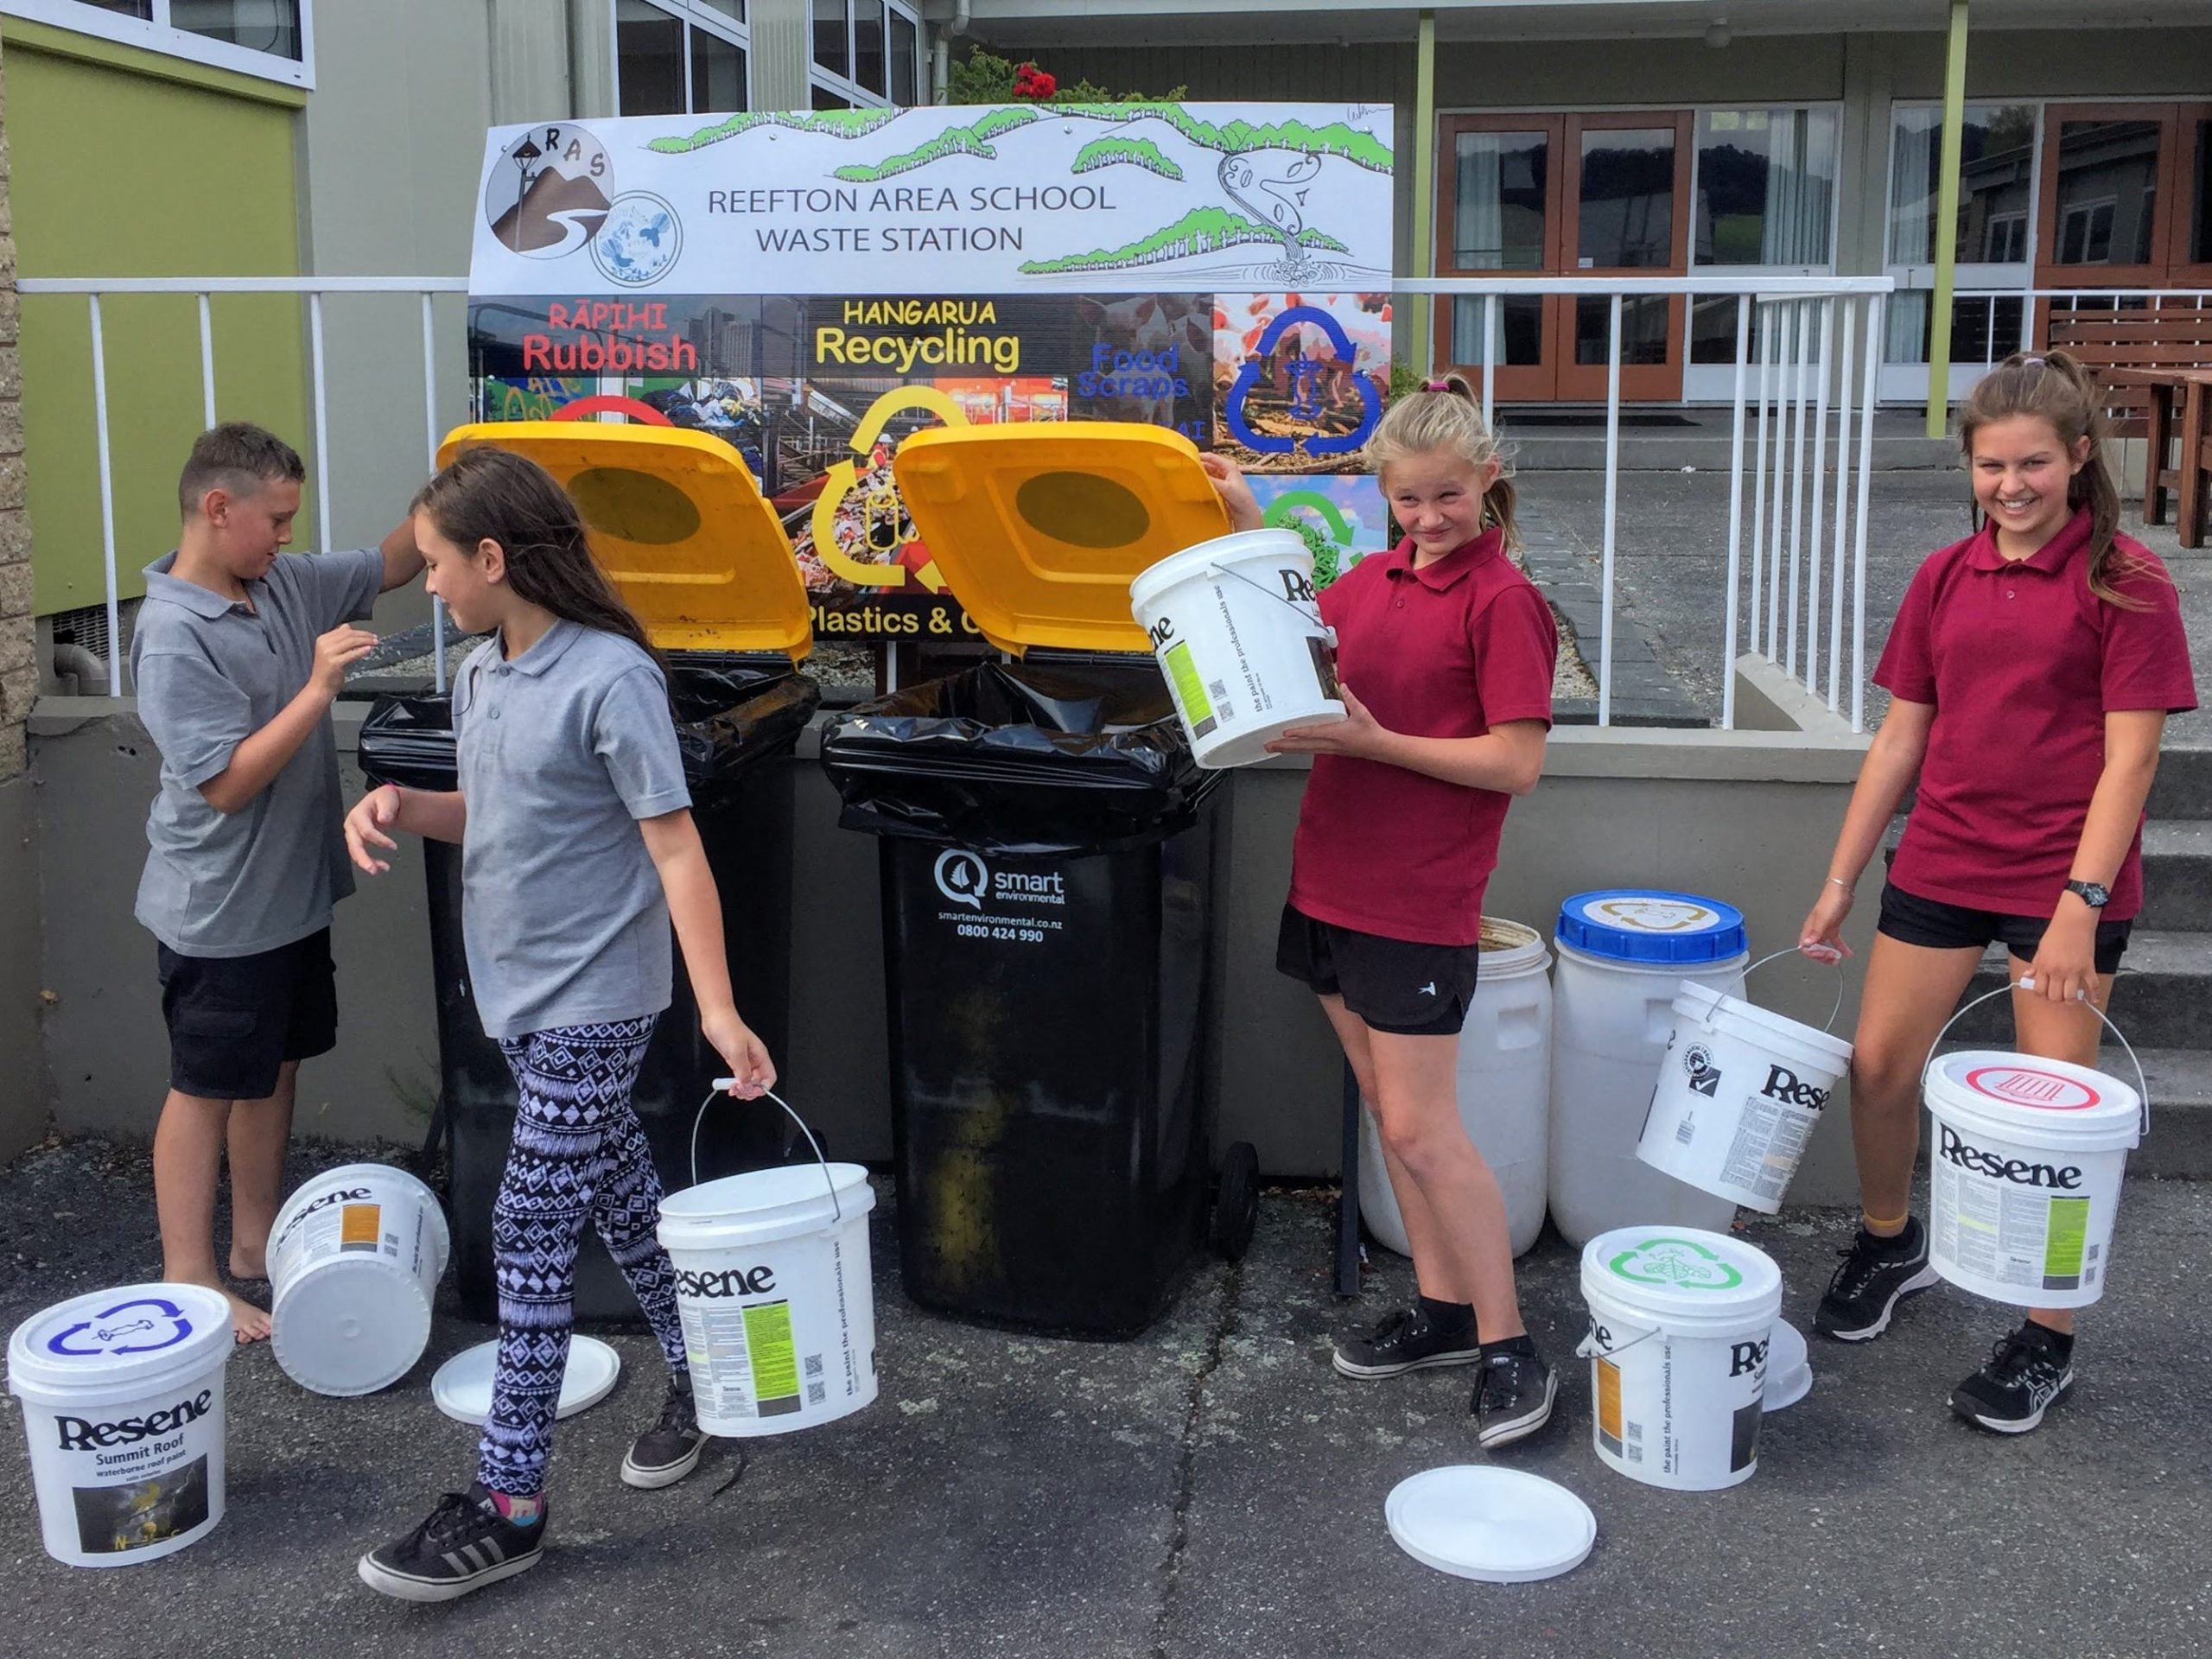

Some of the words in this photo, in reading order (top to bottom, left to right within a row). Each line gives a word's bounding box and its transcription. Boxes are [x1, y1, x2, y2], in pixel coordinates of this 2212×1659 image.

[545, 128, 606, 178] RAS
[709, 188, 858, 214] REEFTON
[869, 188, 959, 212] AREA
[970, 185, 1117, 211] SCHOOL
[756, 228, 870, 252] WASTE
[881, 226, 1023, 252] STATION
[843, 300, 997, 327] HANGARUA
[522, 334, 697, 373] Rubbish
[816, 327, 1020, 375] Recycling
[1092, 341, 1179, 373] Food
[1077, 372, 1189, 402] Scraps
[1160, 420, 1206, 440] AI
[928, 607, 953, 634] &
[994, 871, 1065, 894] smart
[995, 889, 1065, 905] environmental
[938, 912, 1064, 930] smartenvironmental.co.nz
[957, 924, 989, 938] 0800
[991, 926, 1016, 941] 424
[1019, 929, 1044, 943] 990
[1760, 1064, 1830, 1111] Rese
[1939, 1122, 2082, 1190] Resene
[674, 1265, 777, 1298] esene
[54, 1389, 213, 1452] Resene
[95, 1446, 151, 1466] Summit
[153, 1432, 185, 1455] Roof
[95, 1464, 146, 1478] waterborne
[147, 1458, 166, 1470] roof
[166, 1449, 187, 1465] paint
